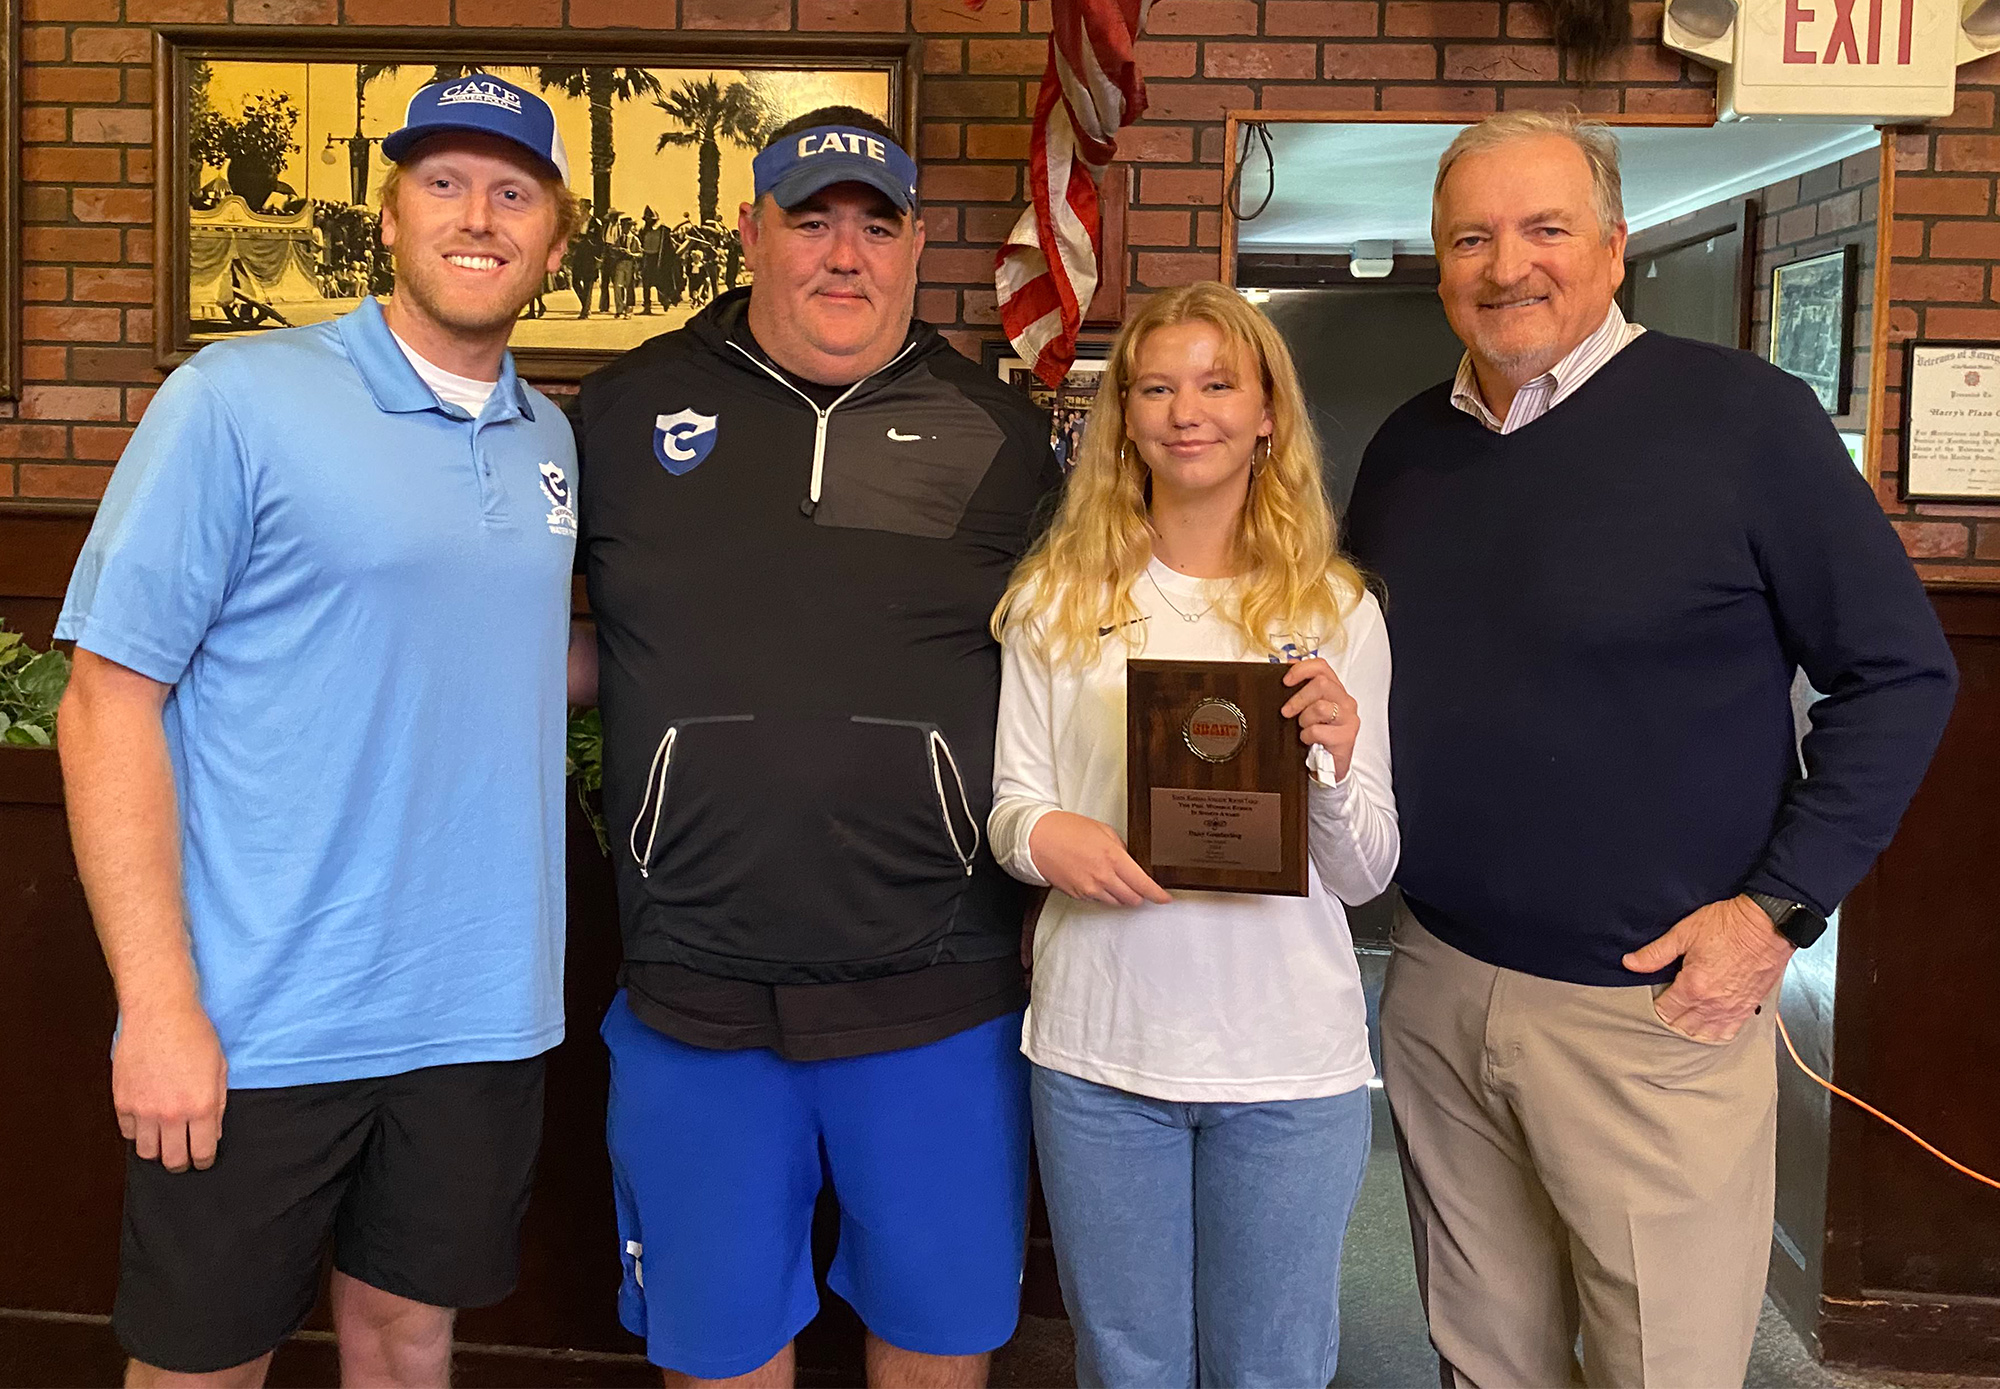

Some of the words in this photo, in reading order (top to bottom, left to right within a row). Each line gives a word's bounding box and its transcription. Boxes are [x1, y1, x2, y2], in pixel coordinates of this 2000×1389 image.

[1782, 0, 1915, 65] EXIT
[442, 81, 521, 105] CATE
[797, 132, 886, 163] CATE
